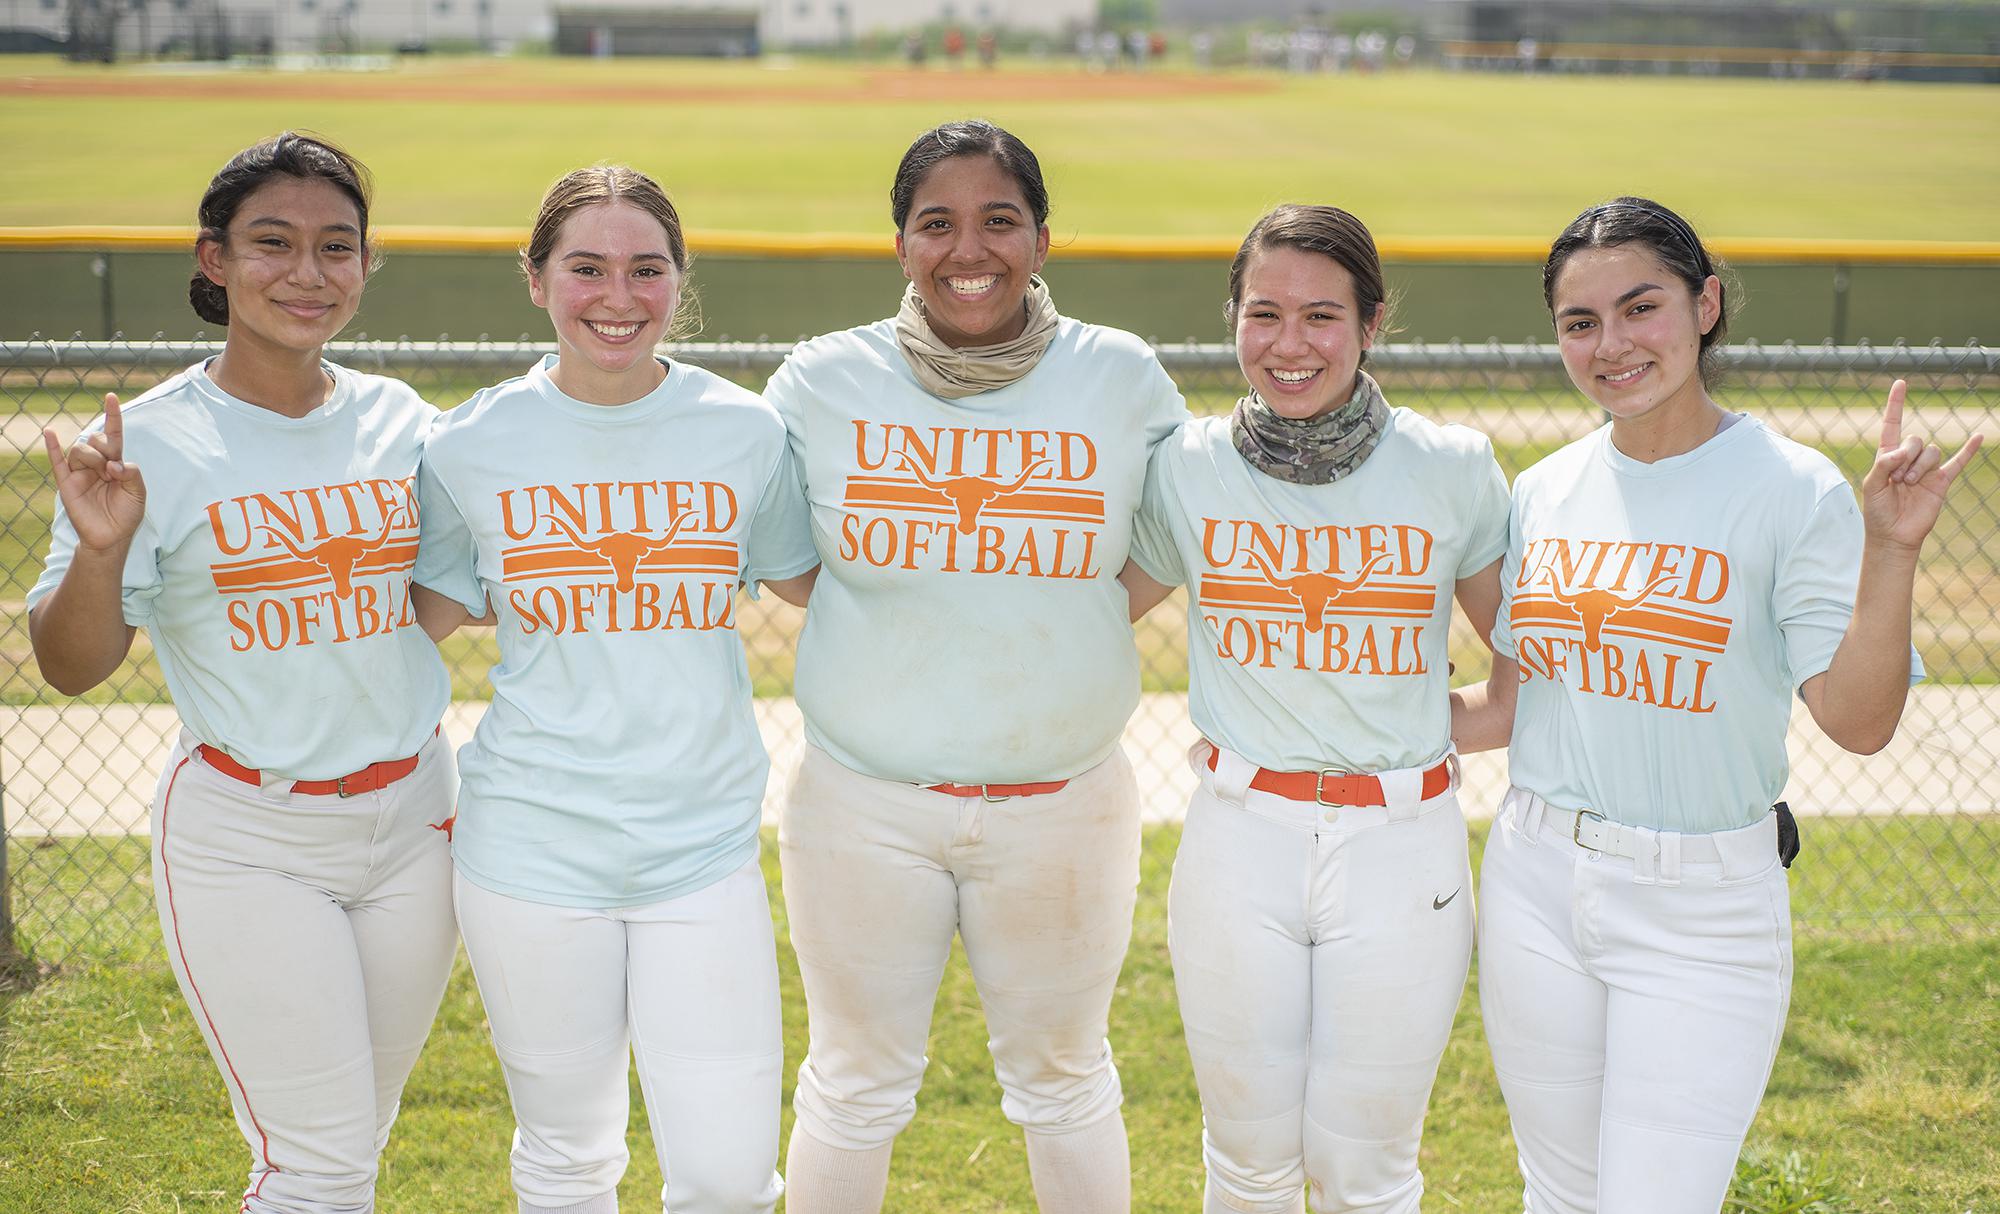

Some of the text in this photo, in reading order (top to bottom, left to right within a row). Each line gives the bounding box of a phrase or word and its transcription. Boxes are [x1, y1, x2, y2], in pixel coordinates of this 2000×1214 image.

[852, 420, 1097, 481] UNITED
[497, 480, 738, 540] UNITED
[839, 513, 1101, 579] SOFTBALL
[1201, 518, 1433, 576] UNITED
[1516, 538, 1730, 605] UNITED
[509, 582, 735, 635] SOFTBALL
